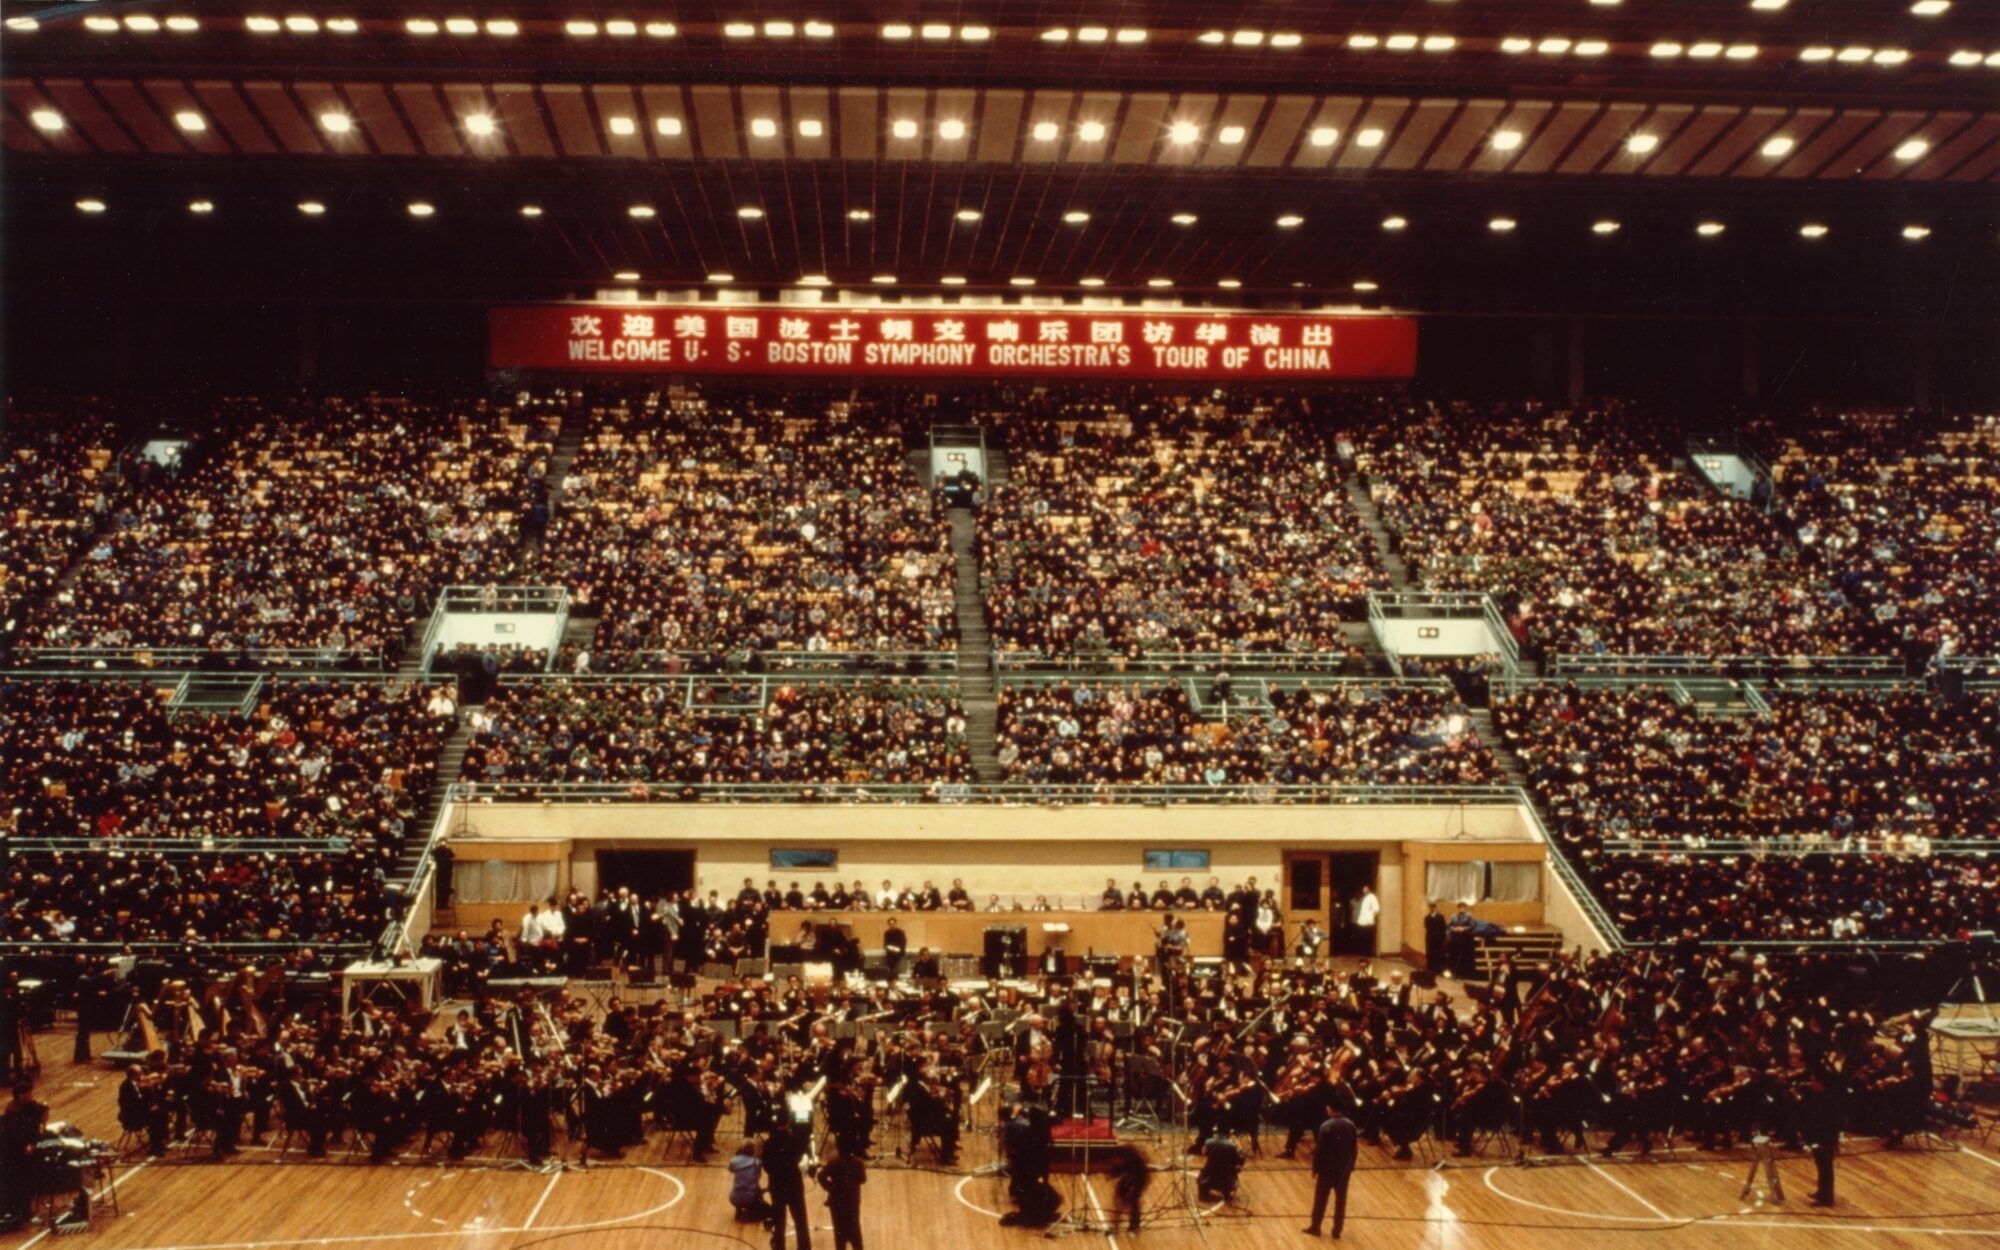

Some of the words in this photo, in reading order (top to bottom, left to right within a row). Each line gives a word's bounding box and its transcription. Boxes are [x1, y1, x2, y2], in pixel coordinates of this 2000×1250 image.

[568, 339, 671, 361] WELCOME
[768, 341, 852, 364] BOSTON
[865, 343, 976, 365] SYMPHONY
[989, 343, 1131, 367] ORCHESTRA'S
[1153, 346, 1209, 368] TOUR
[1222, 347, 1250, 369] OF
[1264, 348, 1331, 370] CHINA
